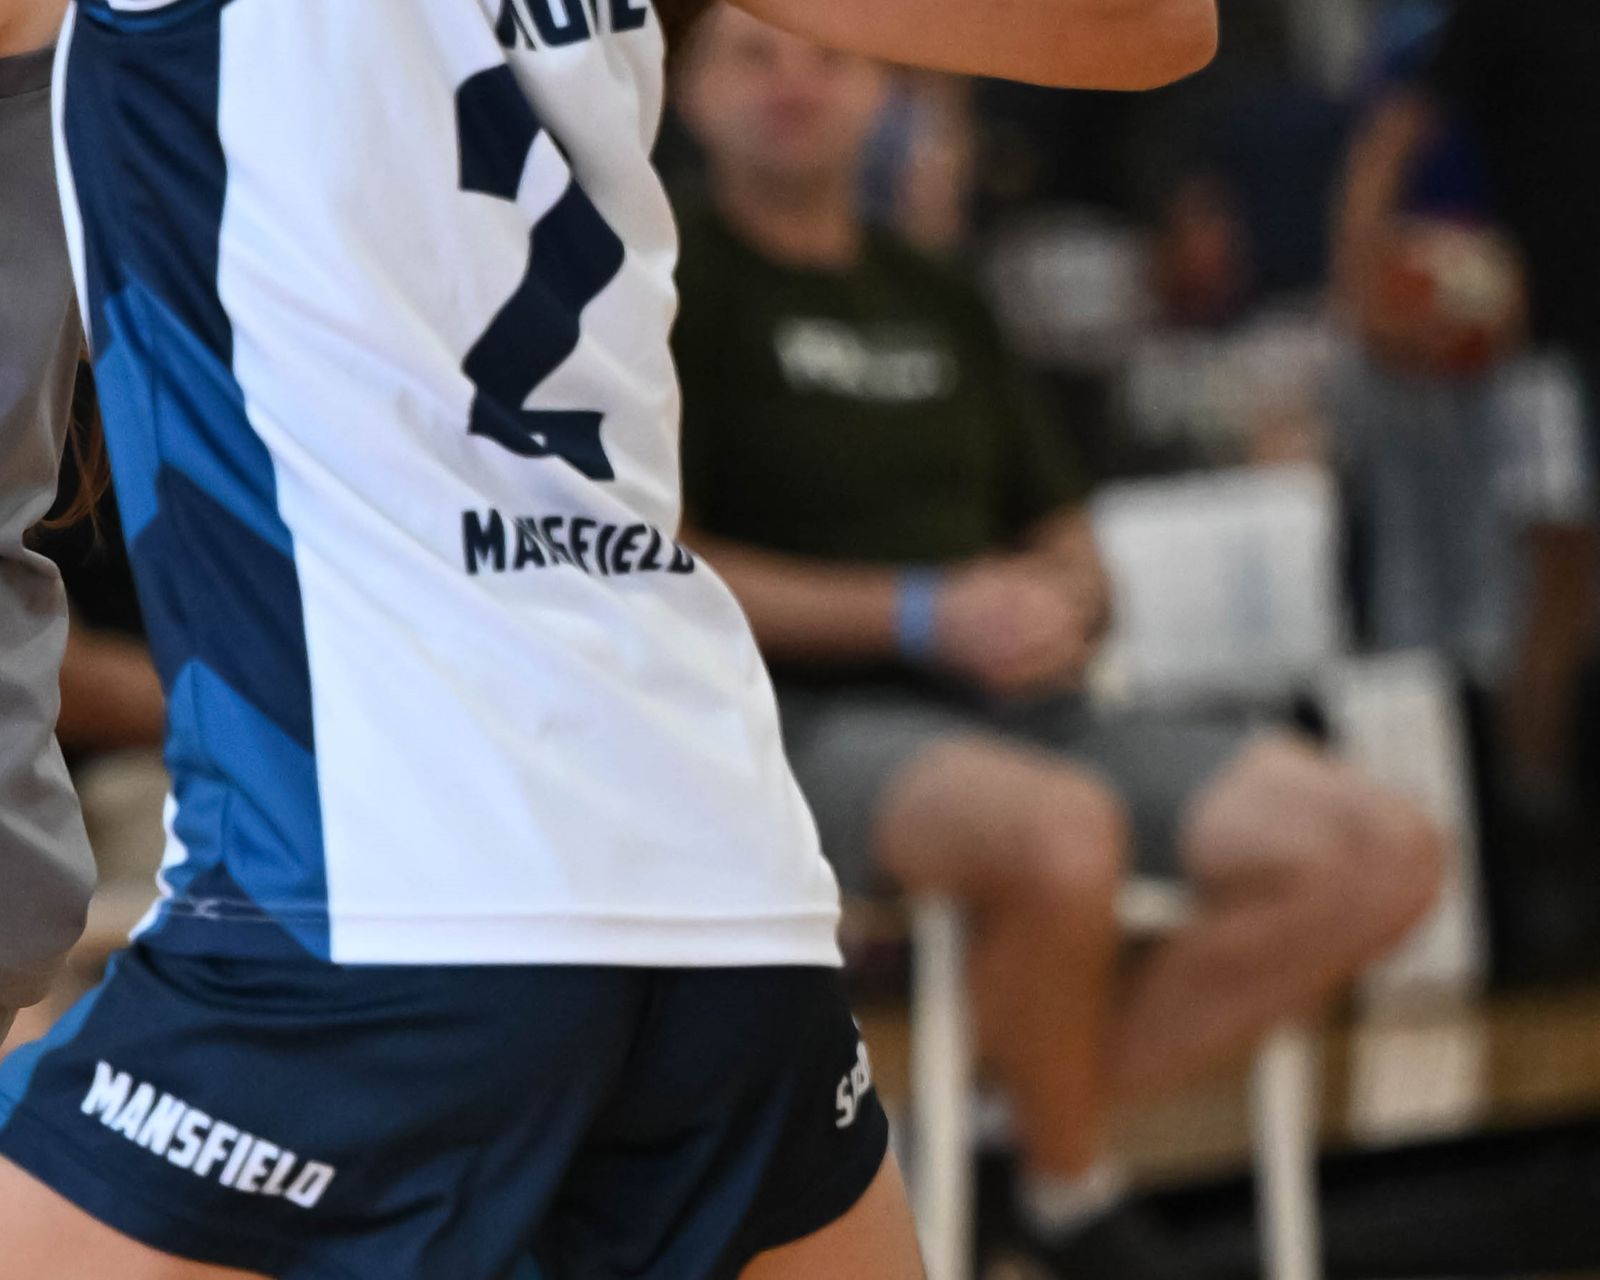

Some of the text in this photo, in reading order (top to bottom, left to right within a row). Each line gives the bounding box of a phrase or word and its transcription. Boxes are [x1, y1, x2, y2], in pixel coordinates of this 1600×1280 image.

[455, 63, 626, 481] 2
[461, 508, 696, 577] MASFIELD
[81, 1059, 336, 1208] MANSFIELD
